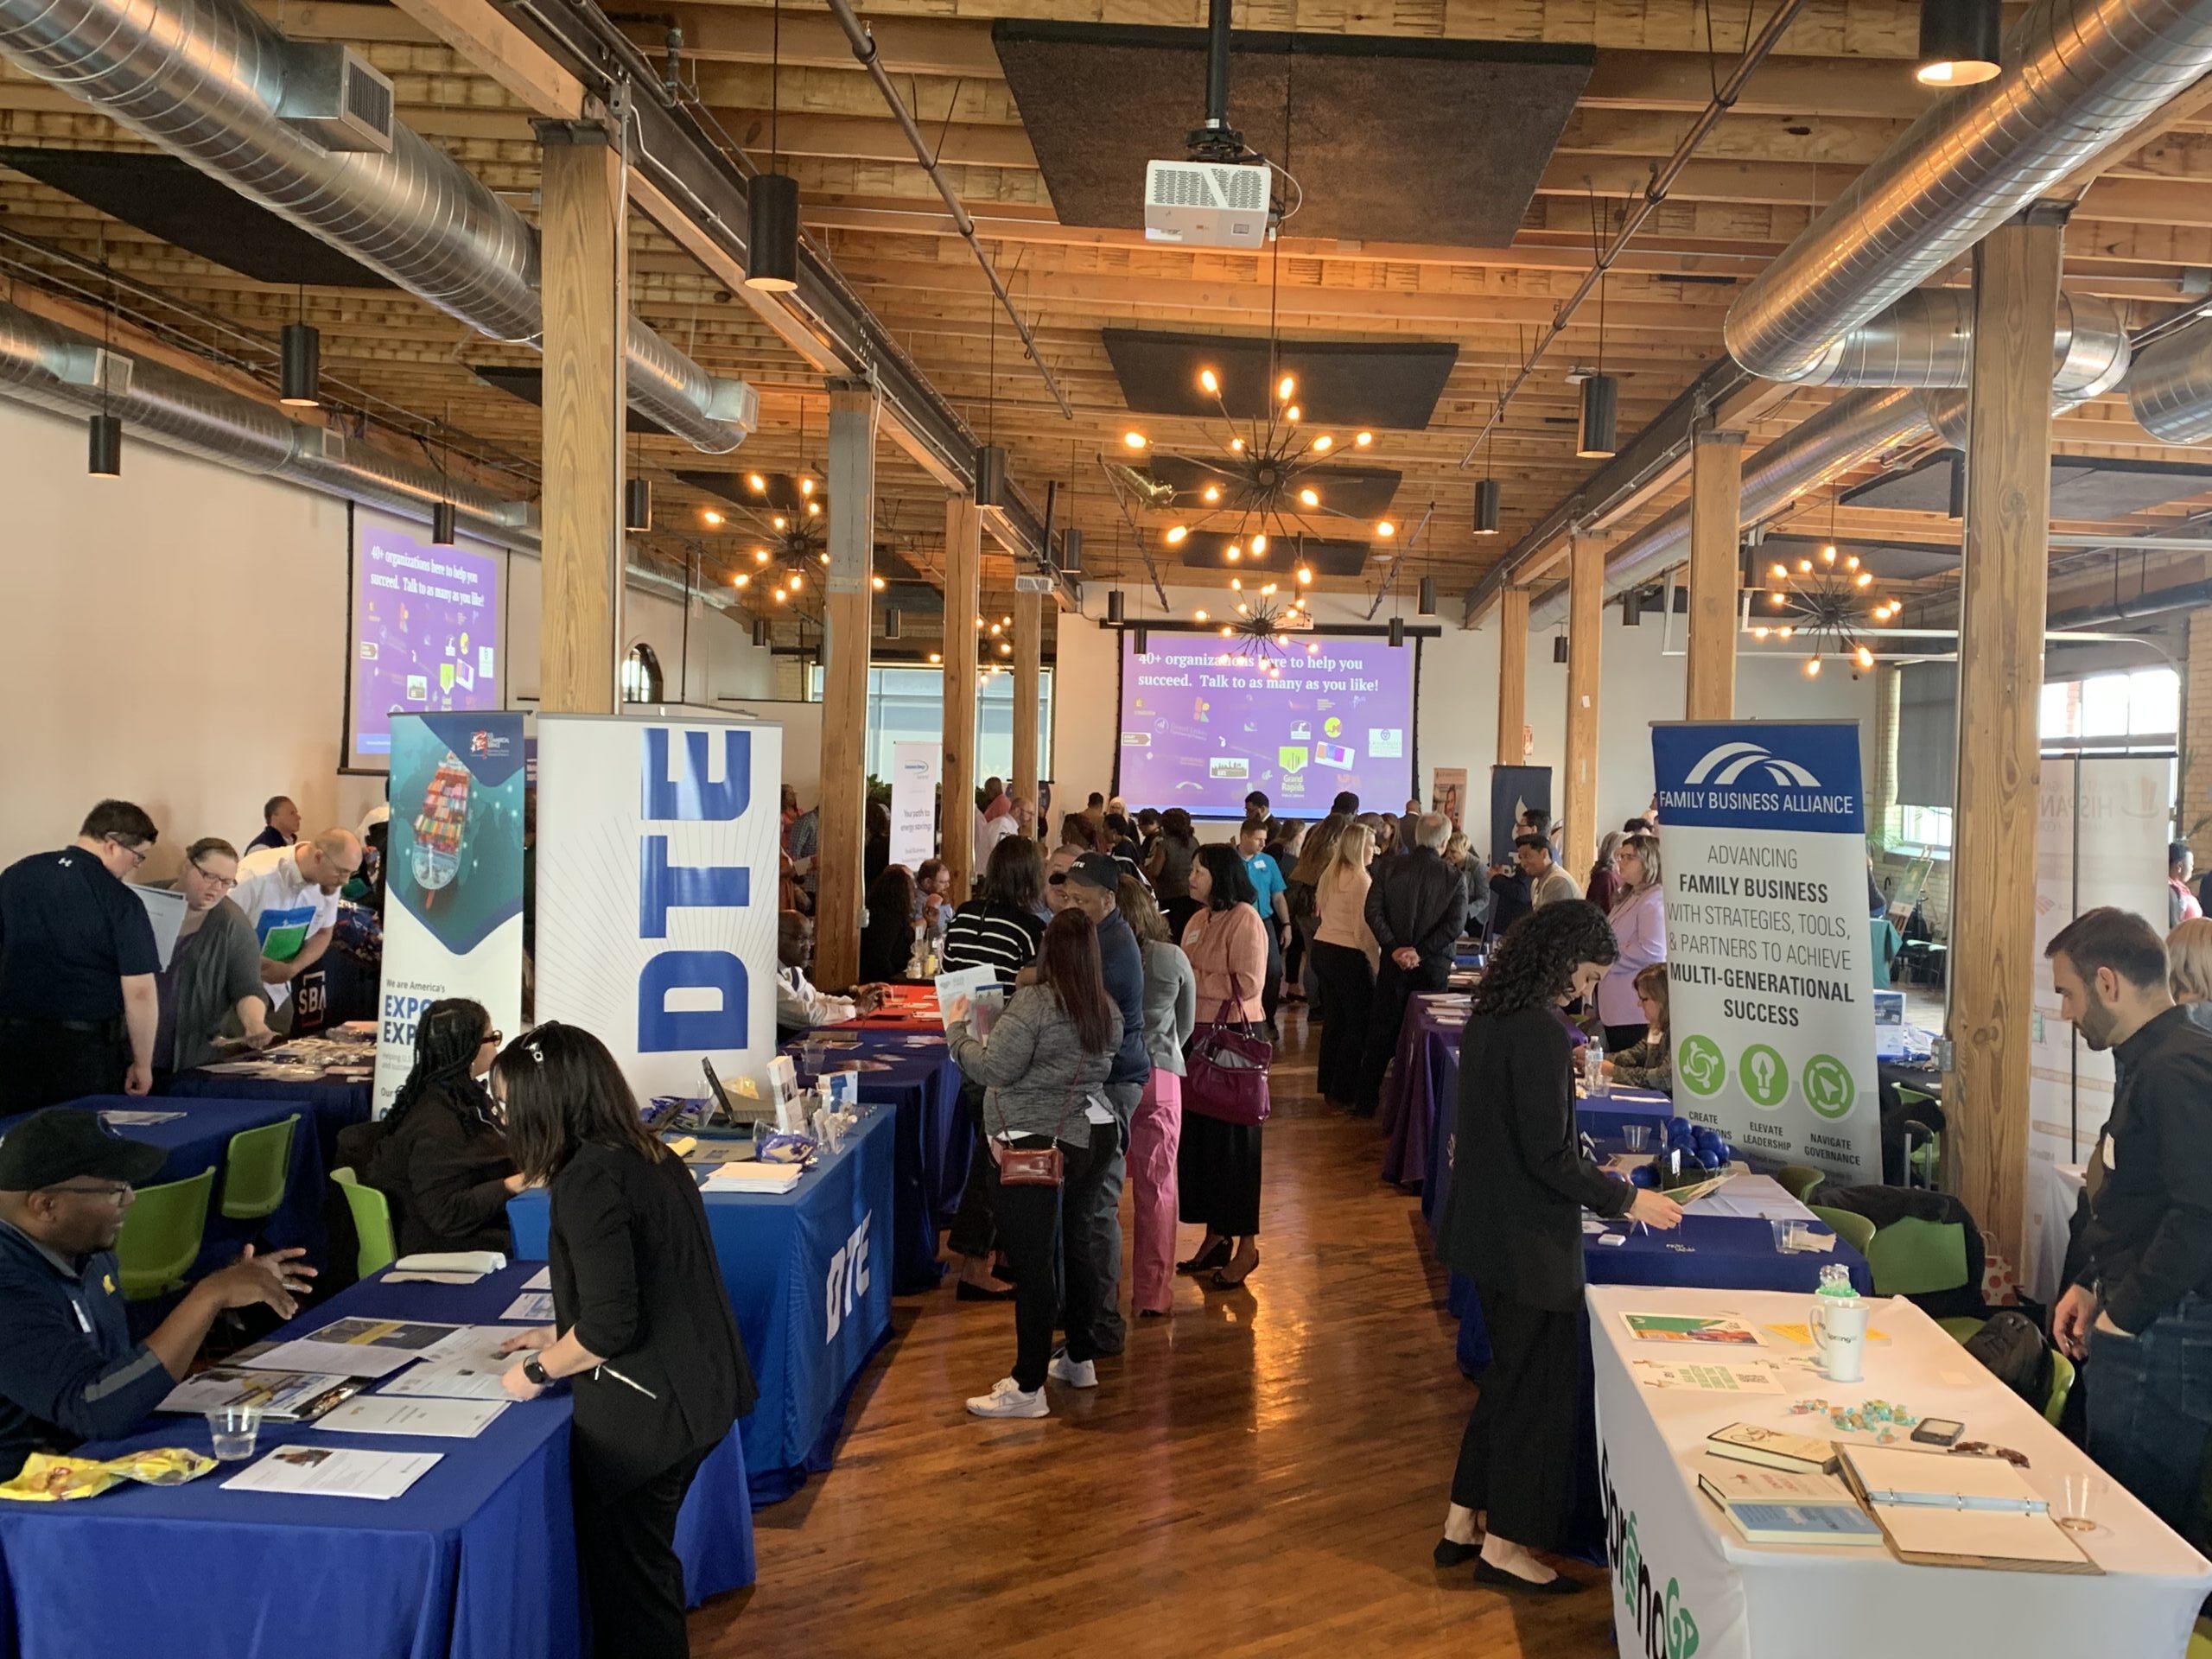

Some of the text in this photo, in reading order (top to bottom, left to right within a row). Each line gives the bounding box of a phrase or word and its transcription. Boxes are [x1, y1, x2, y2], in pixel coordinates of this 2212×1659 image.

[371, 545, 478, 584] 40+ organizations here to help you
[371, 573, 485, 607] succeed. Talk to as many as you like!
[1138, 652, 1162, 665] 40+
[1290, 655, 1304, 669] to
[1307, 655, 1336, 671] help
[1338, 658, 1363, 672] you
[1138, 674, 1379, 693] succeed. Talk to as many as you like!
[1281, 783, 1305, 792] Rapids
[1283, 774, 1303, 783] Grand
[1660, 791, 1853, 814] FAMILY BUSINESS ALLIANCE
[1707, 845, 1797, 869] ADVANCING
[638, 728, 751, 1052] DTE
[1680, 874, 1828, 904] FAMILY BUSINESS
[1667, 902, 1851, 941] WITH STRATEGIES, TOOLS,
[1669, 932, 1852, 970] & PARTNERS TO ACHIEVE
[386, 979, 395, 988] We
[410, 981, 445, 993] America's
[1670, 962, 1855, 1003] MULTI-GENERATIONAL
[385, 995, 433, 1020] EXPO
[1724, 999, 1799, 1027] SUCCESS
[381, 1087, 392, 1097] Our
[1688, 1111, 1718, 1124] CREATE
[1750, 1122, 1783, 1136] ELEVATE
[1743, 1134, 1791, 1151] LEADERSHIP
[1810, 1133, 1852, 1150] NAVIGATE
[1804, 1146, 1861, 1166] GOVERNANCE
